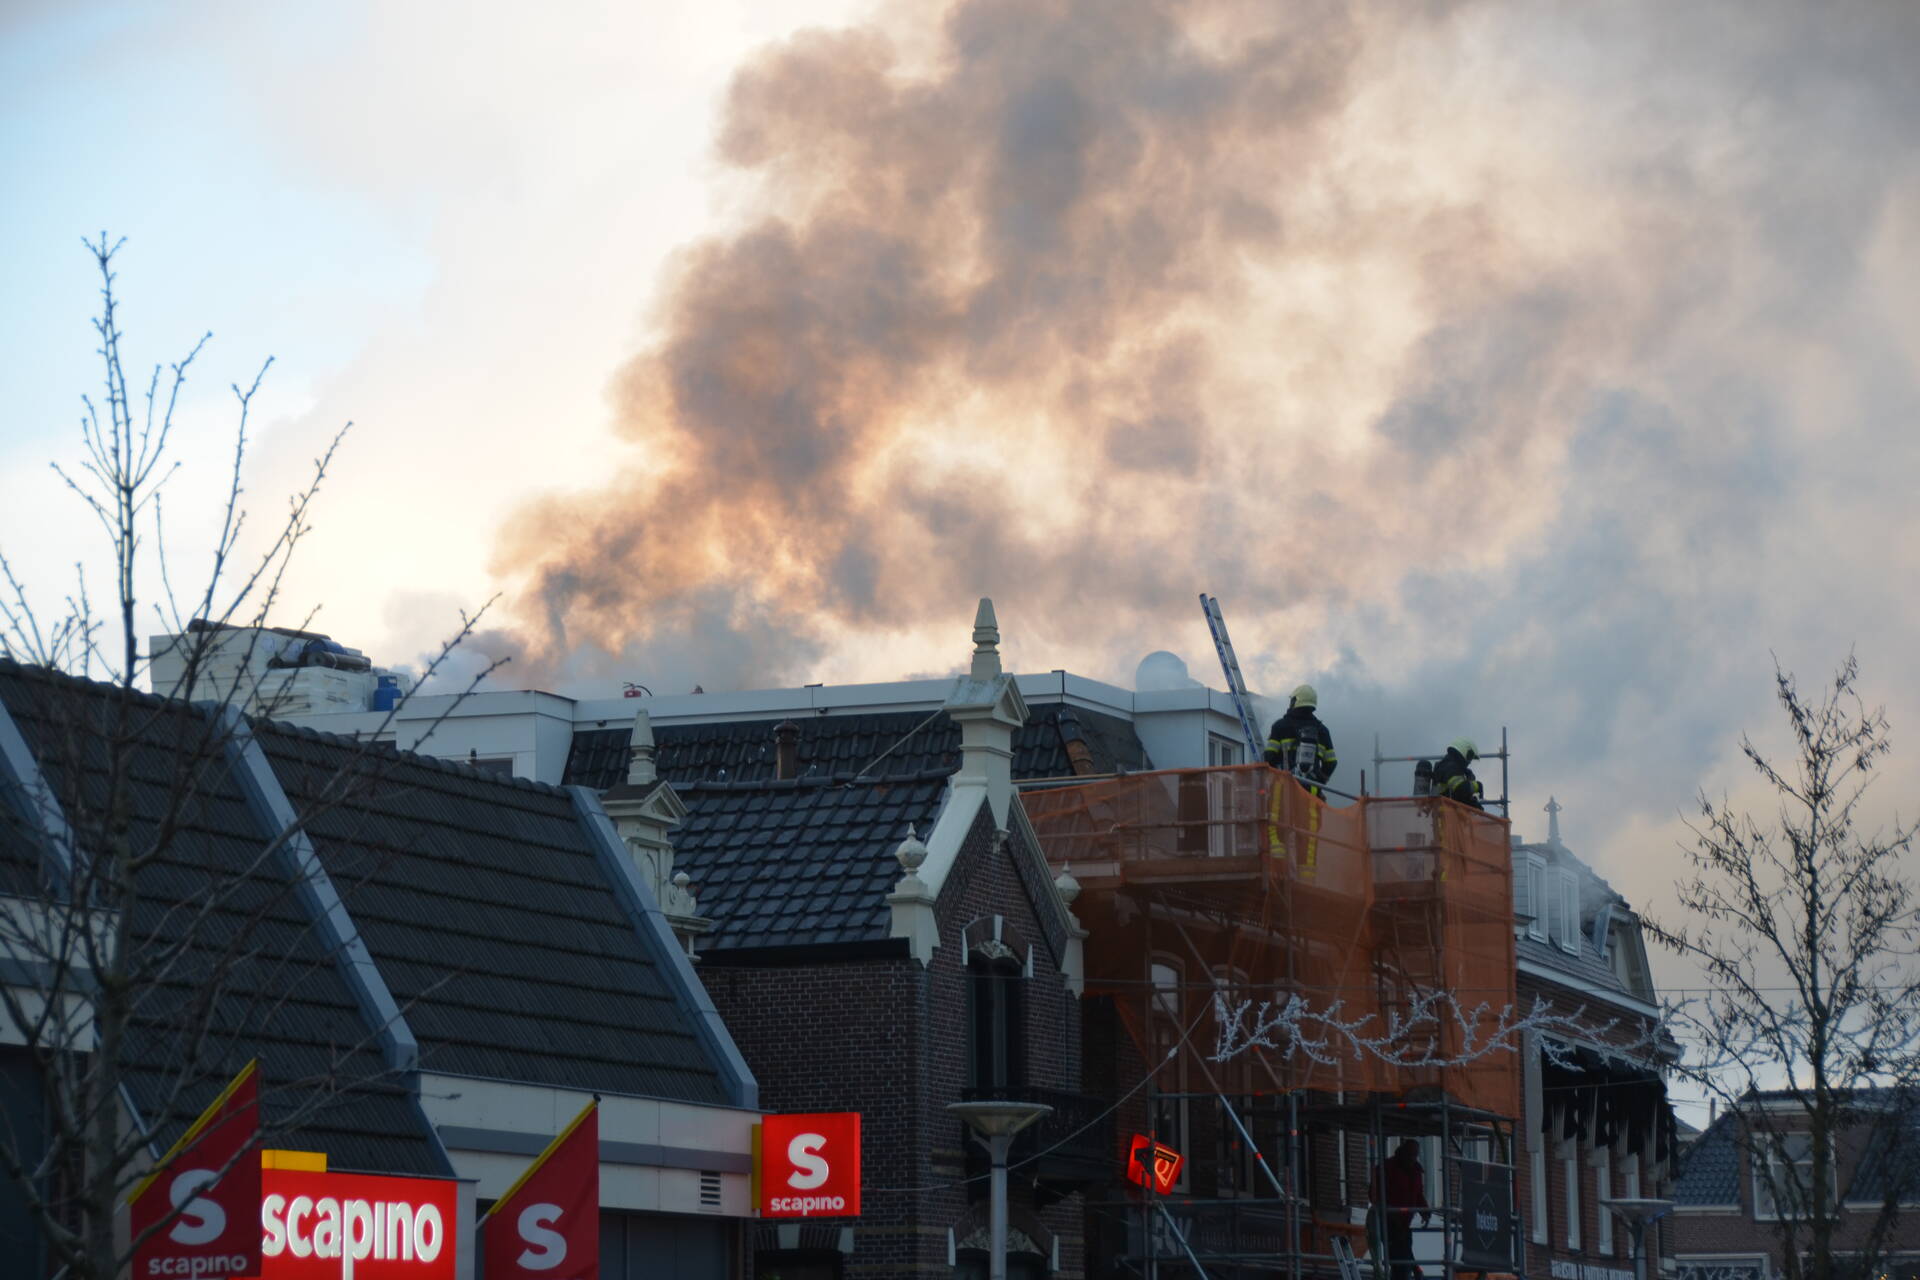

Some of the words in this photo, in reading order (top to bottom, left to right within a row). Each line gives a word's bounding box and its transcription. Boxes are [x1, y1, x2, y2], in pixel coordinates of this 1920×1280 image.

[787, 1133, 829, 1189] S
[169, 1169, 226, 1245] S
[516, 1203, 567, 1270] S
[770, 1196, 845, 1216] scapino
[148, 1255, 248, 1280] scapino
[262, 1194, 443, 1280] scapino
